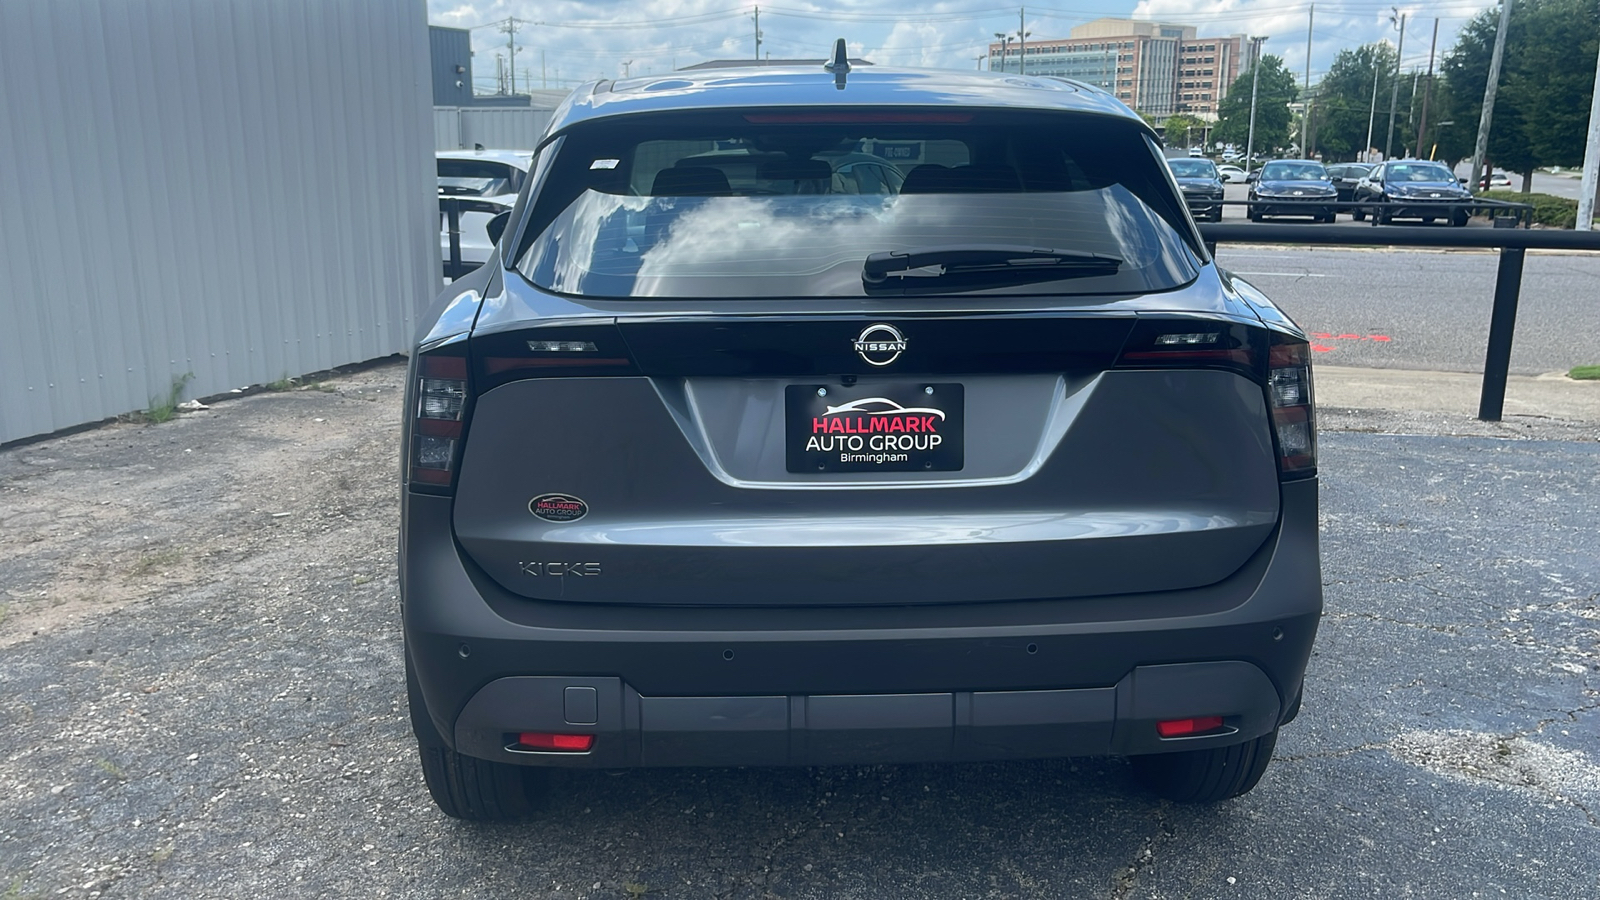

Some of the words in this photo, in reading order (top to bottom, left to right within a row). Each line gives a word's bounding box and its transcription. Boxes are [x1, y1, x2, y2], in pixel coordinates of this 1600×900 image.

[855, 343, 906, 351] NISSAN
[813, 416, 936, 434] HALLMARK
[806, 436, 864, 451] AUTO
[869, 435, 942, 450] GROUP
[840, 453, 908, 464] Birmingham
[537, 502, 580, 510] HALLMARK
[518, 561, 602, 576] KICKS
